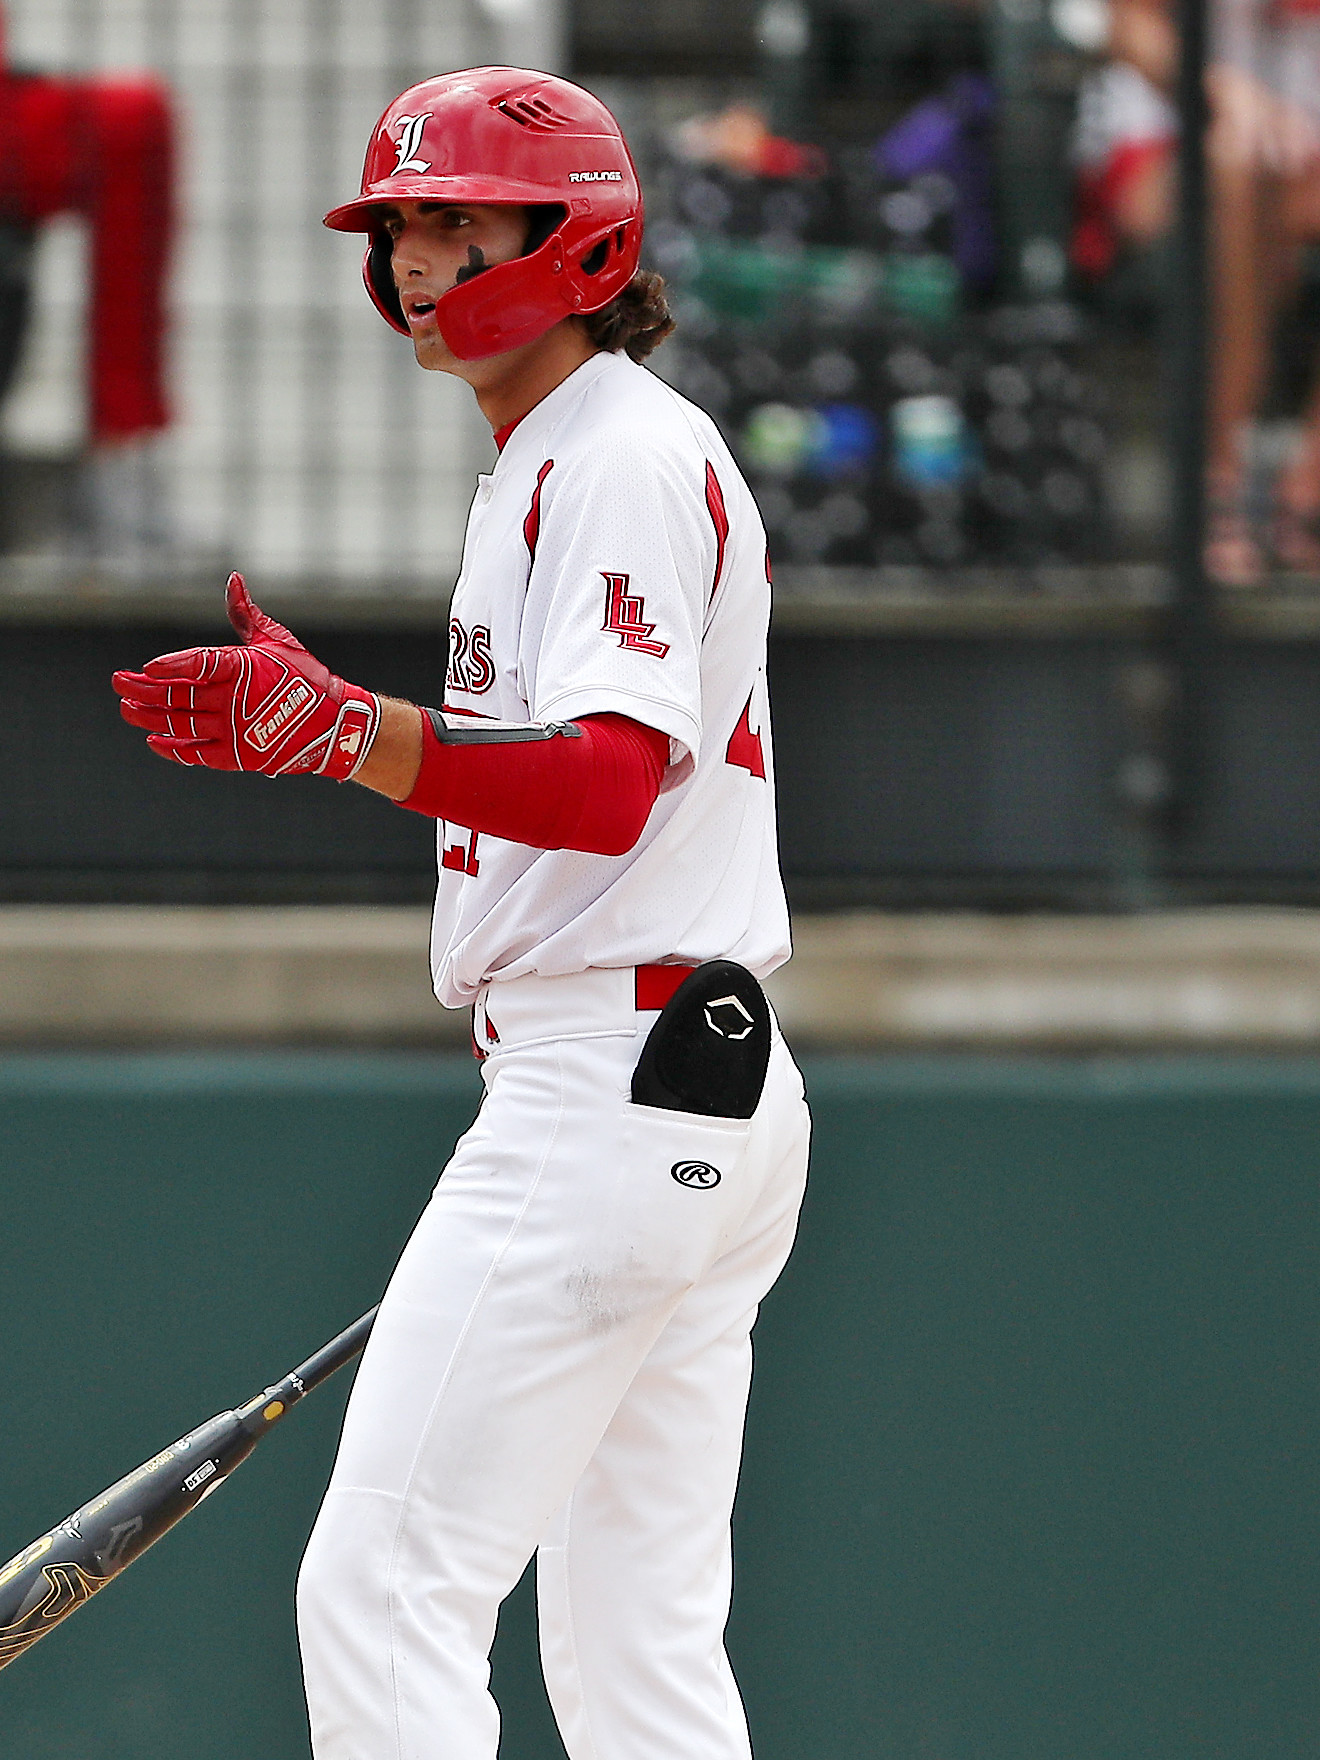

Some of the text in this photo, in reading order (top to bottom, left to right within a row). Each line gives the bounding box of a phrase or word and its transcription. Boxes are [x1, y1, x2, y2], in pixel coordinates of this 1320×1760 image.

[390, 112, 434, 177] L
[568, 171, 622, 183] RAWLINGS
[598, 571, 671, 660] LL
